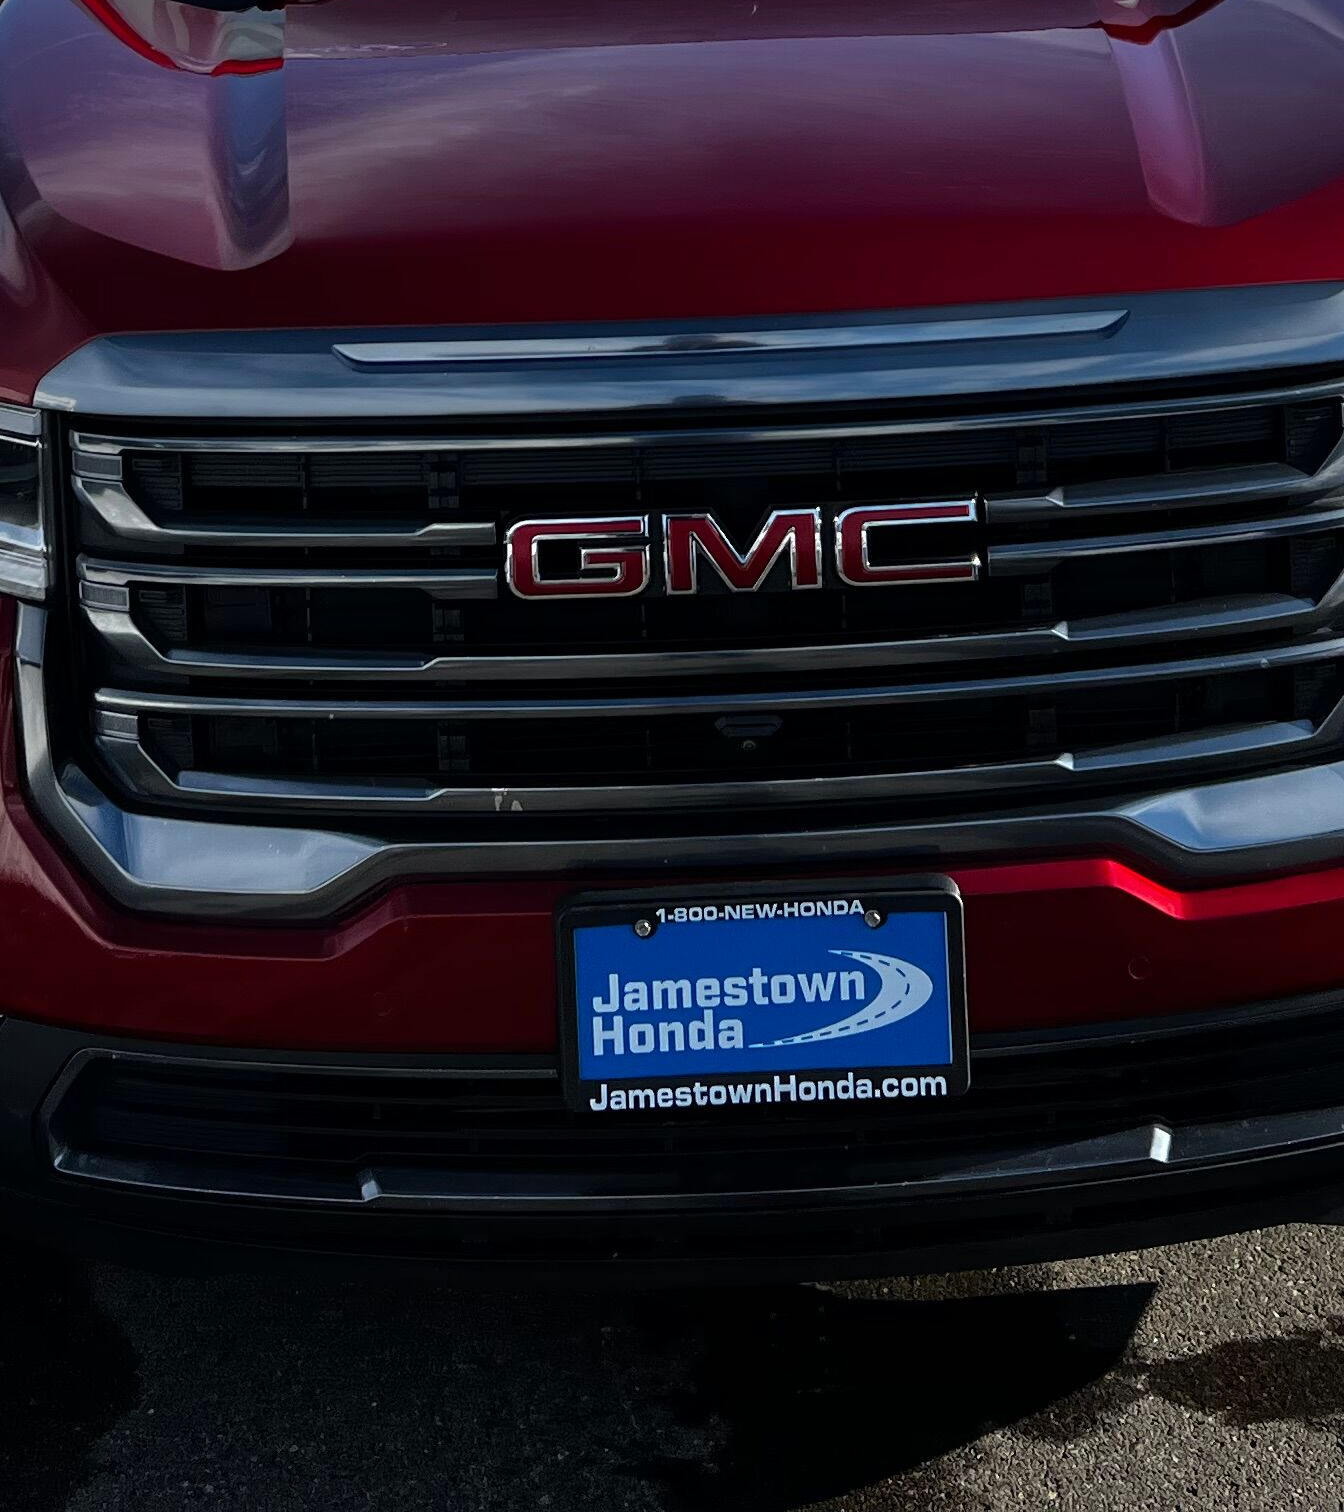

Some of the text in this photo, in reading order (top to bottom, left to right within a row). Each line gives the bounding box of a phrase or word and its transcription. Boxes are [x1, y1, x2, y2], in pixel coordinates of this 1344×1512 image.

[504, 499, 980, 600] GMC
[655, 899, 865, 924] 1-800-NEW-HONDA
[592, 967, 866, 1014] Jamestown
[592, 1008, 745, 1057] Honda
[589, 1071, 948, 1113] JamestownHonda.com
